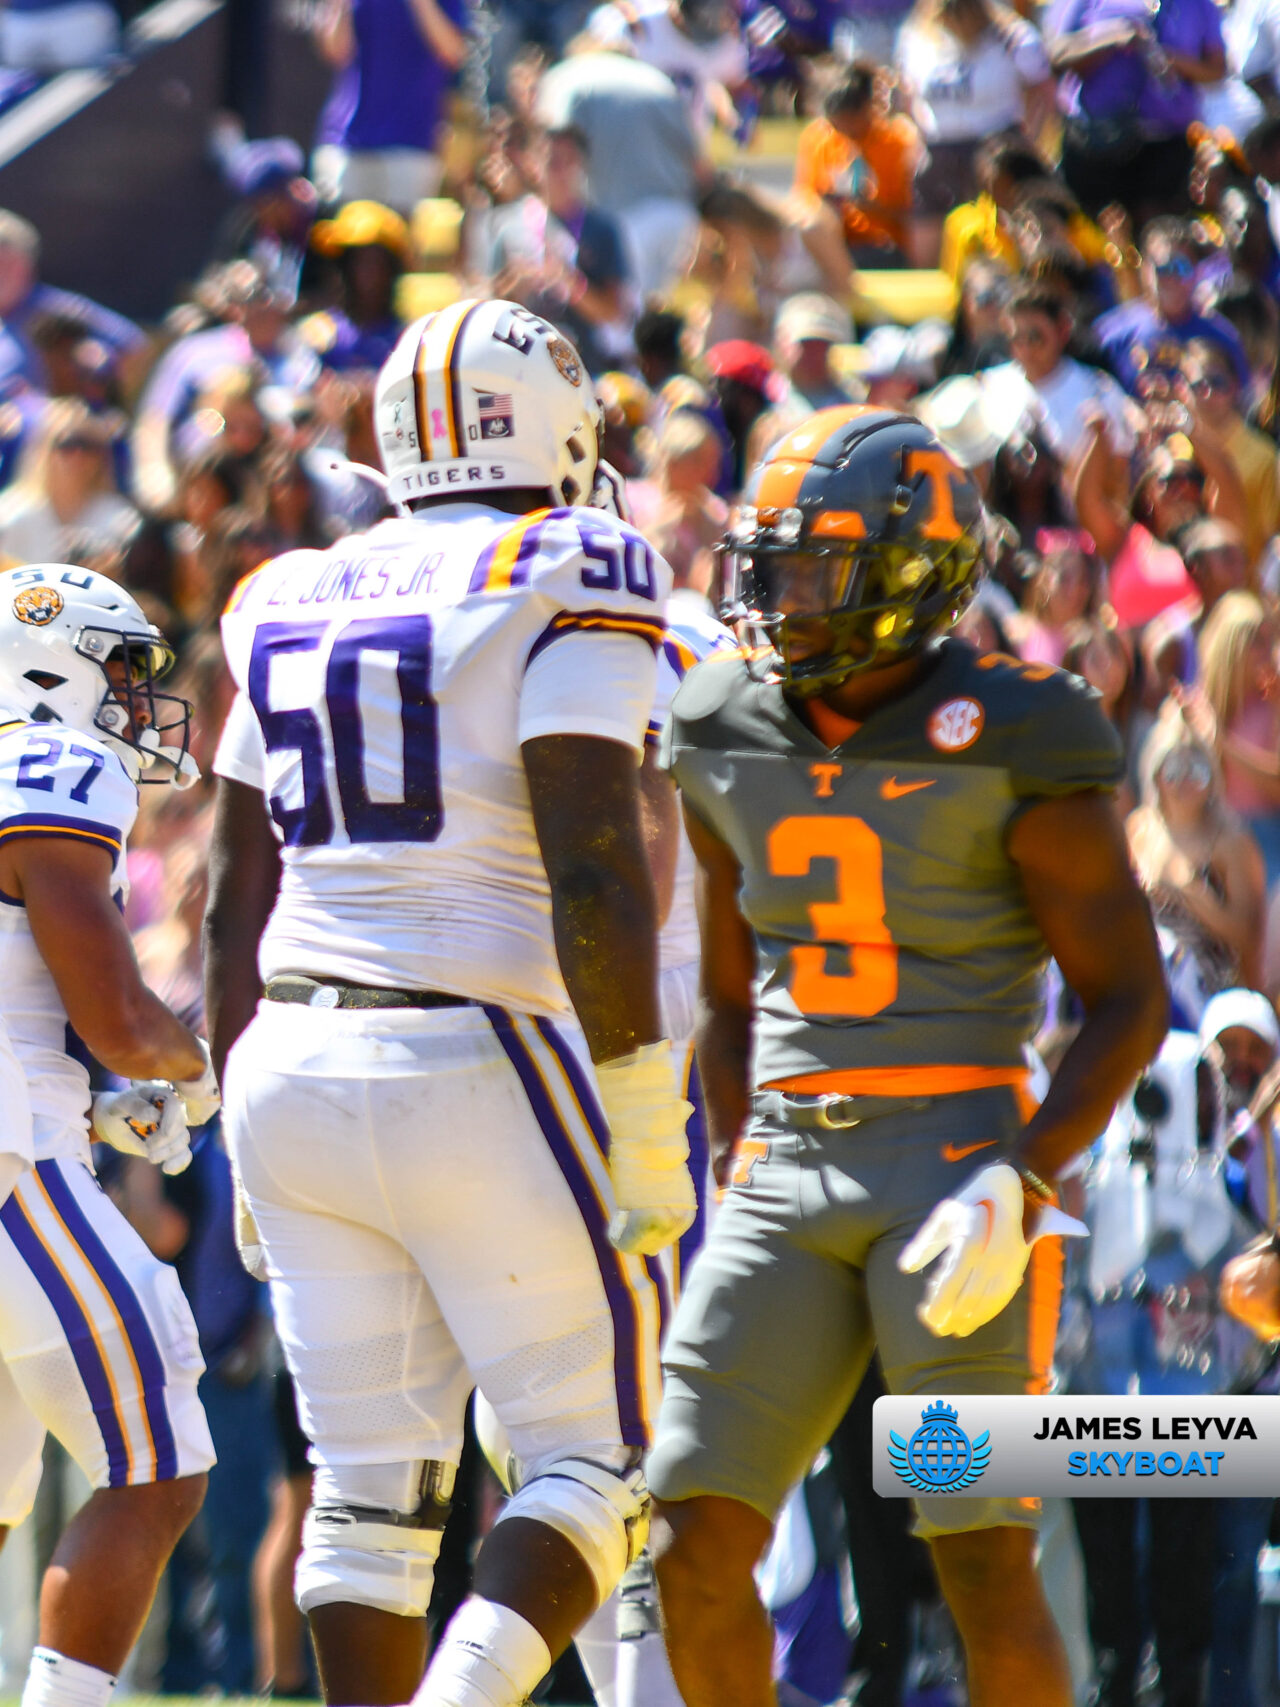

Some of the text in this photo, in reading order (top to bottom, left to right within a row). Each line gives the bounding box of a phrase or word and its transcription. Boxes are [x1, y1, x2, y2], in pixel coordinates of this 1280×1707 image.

[403, 465, 505, 490] TIGERS
[904, 450, 967, 539] T
[297, 556, 400, 605] JONES
[395, 552, 446, 597] JR.
[576, 524, 658, 602] 50
[248, 614, 445, 849] 50
[935, 700, 981, 746] SEC
[16, 736, 105, 805] 27
[808, 762, 843, 798] T
[767, 814, 899, 1017] 3
